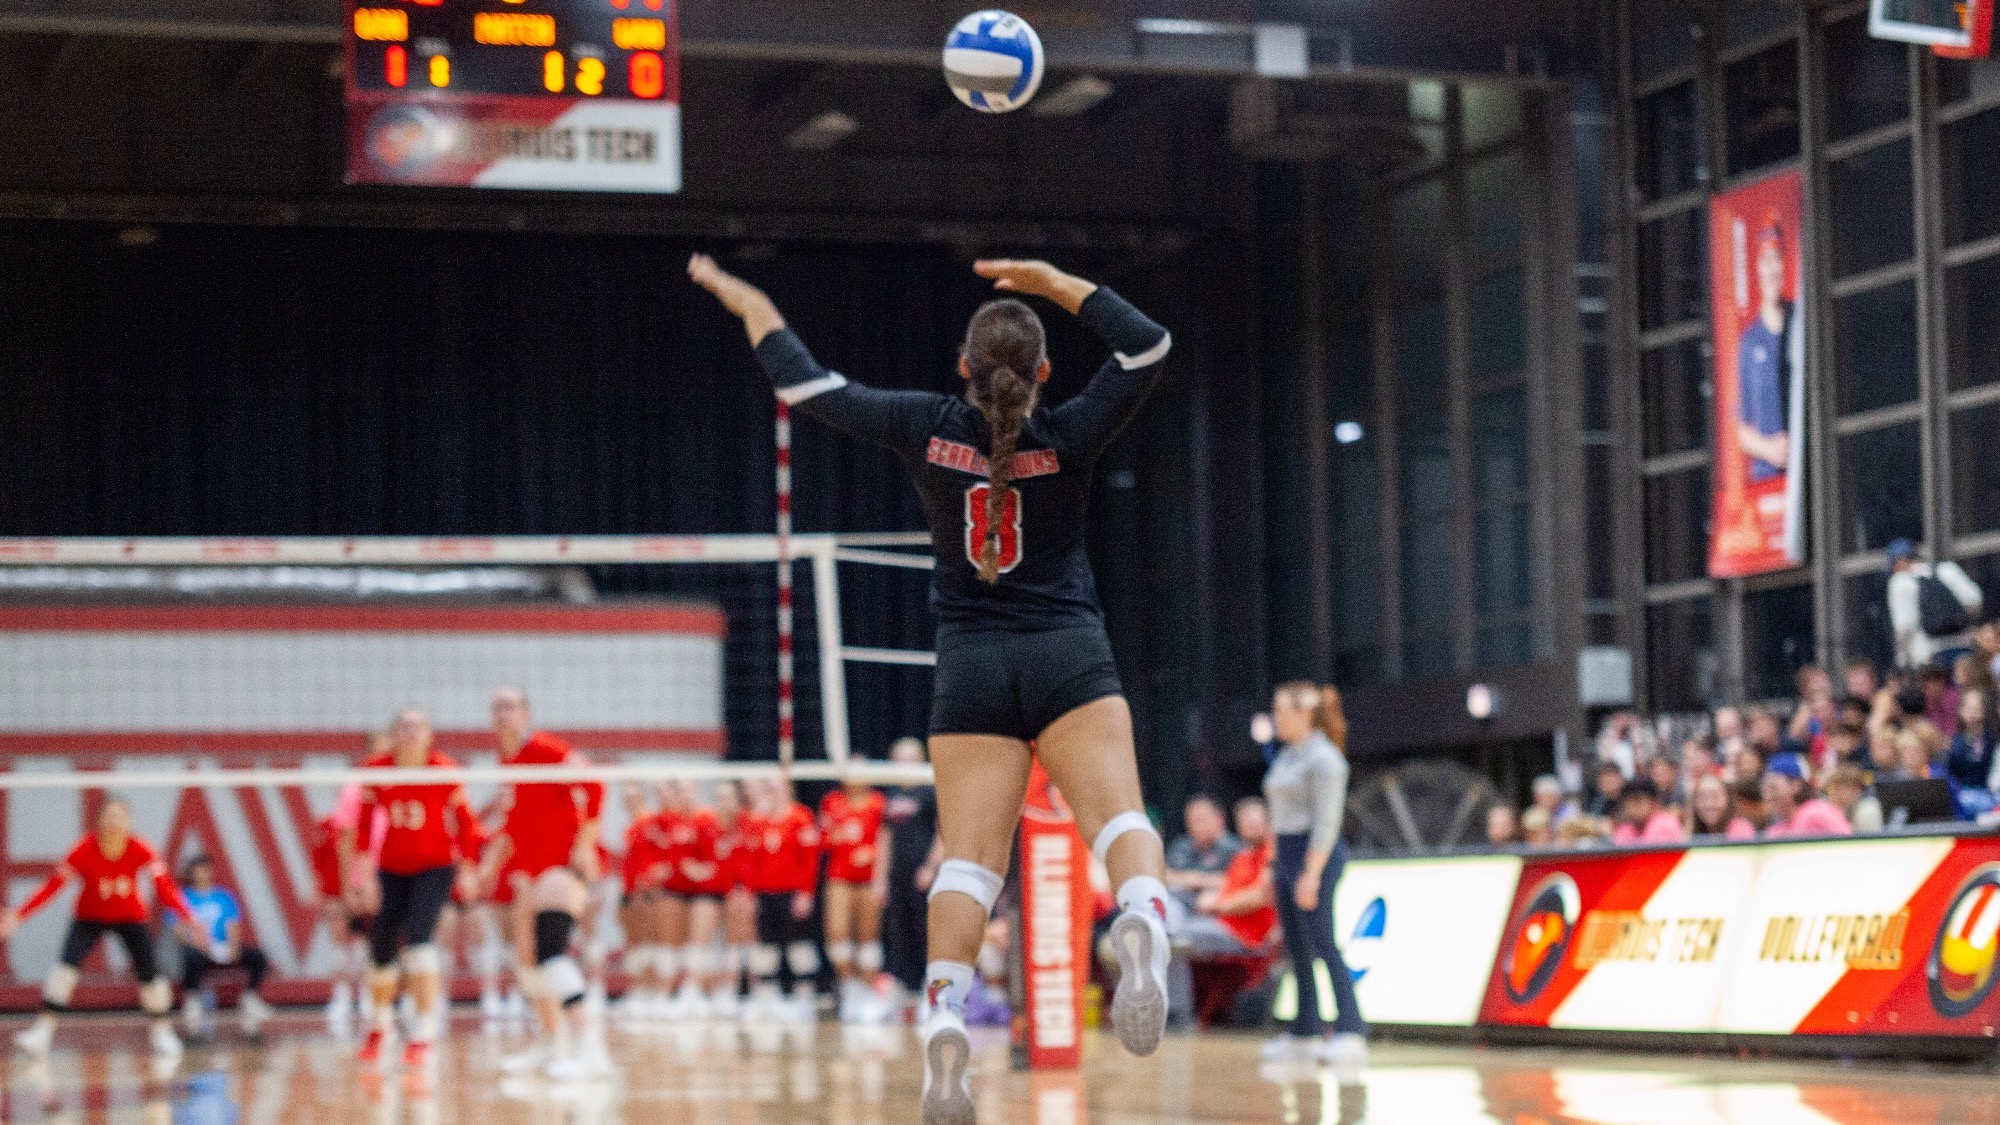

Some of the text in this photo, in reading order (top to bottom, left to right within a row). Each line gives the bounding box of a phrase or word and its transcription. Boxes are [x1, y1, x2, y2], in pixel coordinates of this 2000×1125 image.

[385, 45, 407, 87] 1
[575, 57, 605, 95] 2
[628, 51, 665, 98] 0
[965, 481, 1023, 573] 8
[1031, 833, 1074, 1047] ILLINOIS TECH
[1673, 914, 1726, 962] TECH
[1759, 905, 1911, 970] VOLLEYBALL
